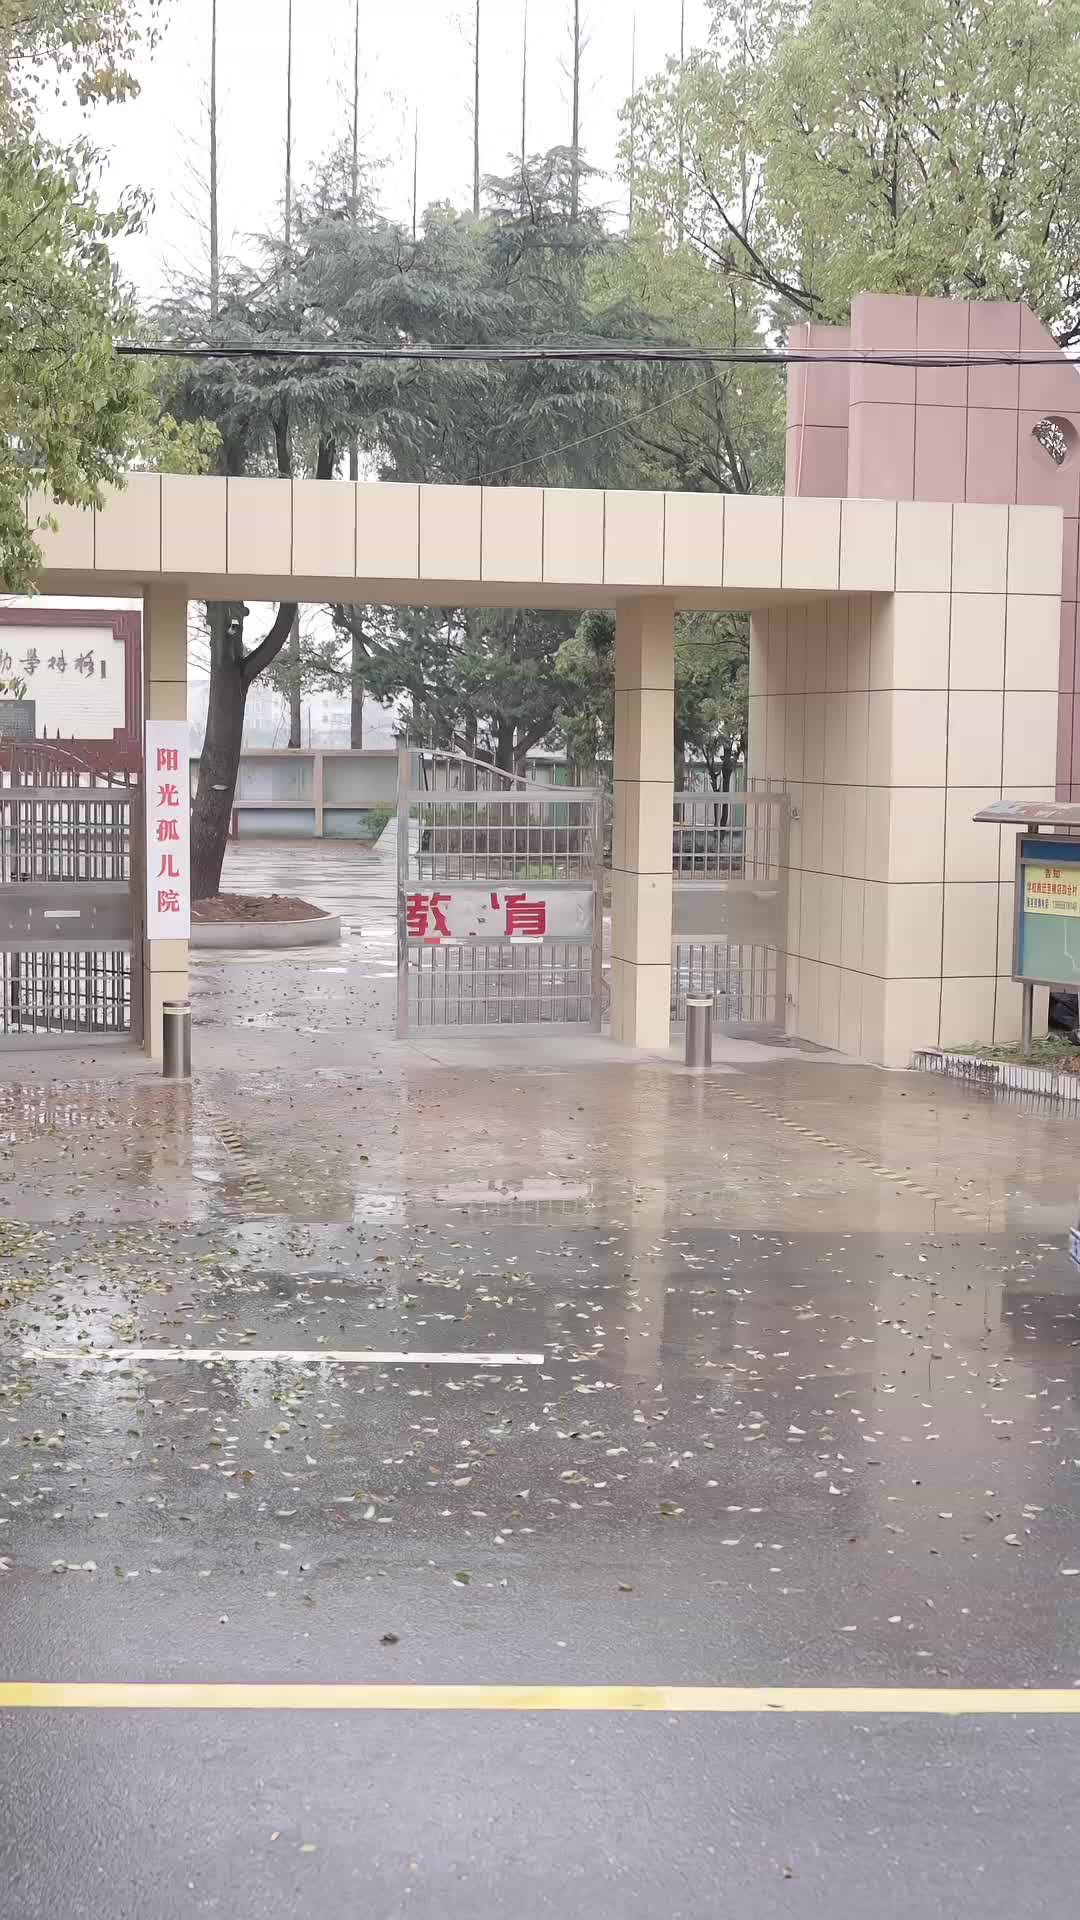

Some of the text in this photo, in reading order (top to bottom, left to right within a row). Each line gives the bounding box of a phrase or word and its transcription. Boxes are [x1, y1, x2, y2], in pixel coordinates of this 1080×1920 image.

[157, 748, 180, 912] 阳光孤儿院
